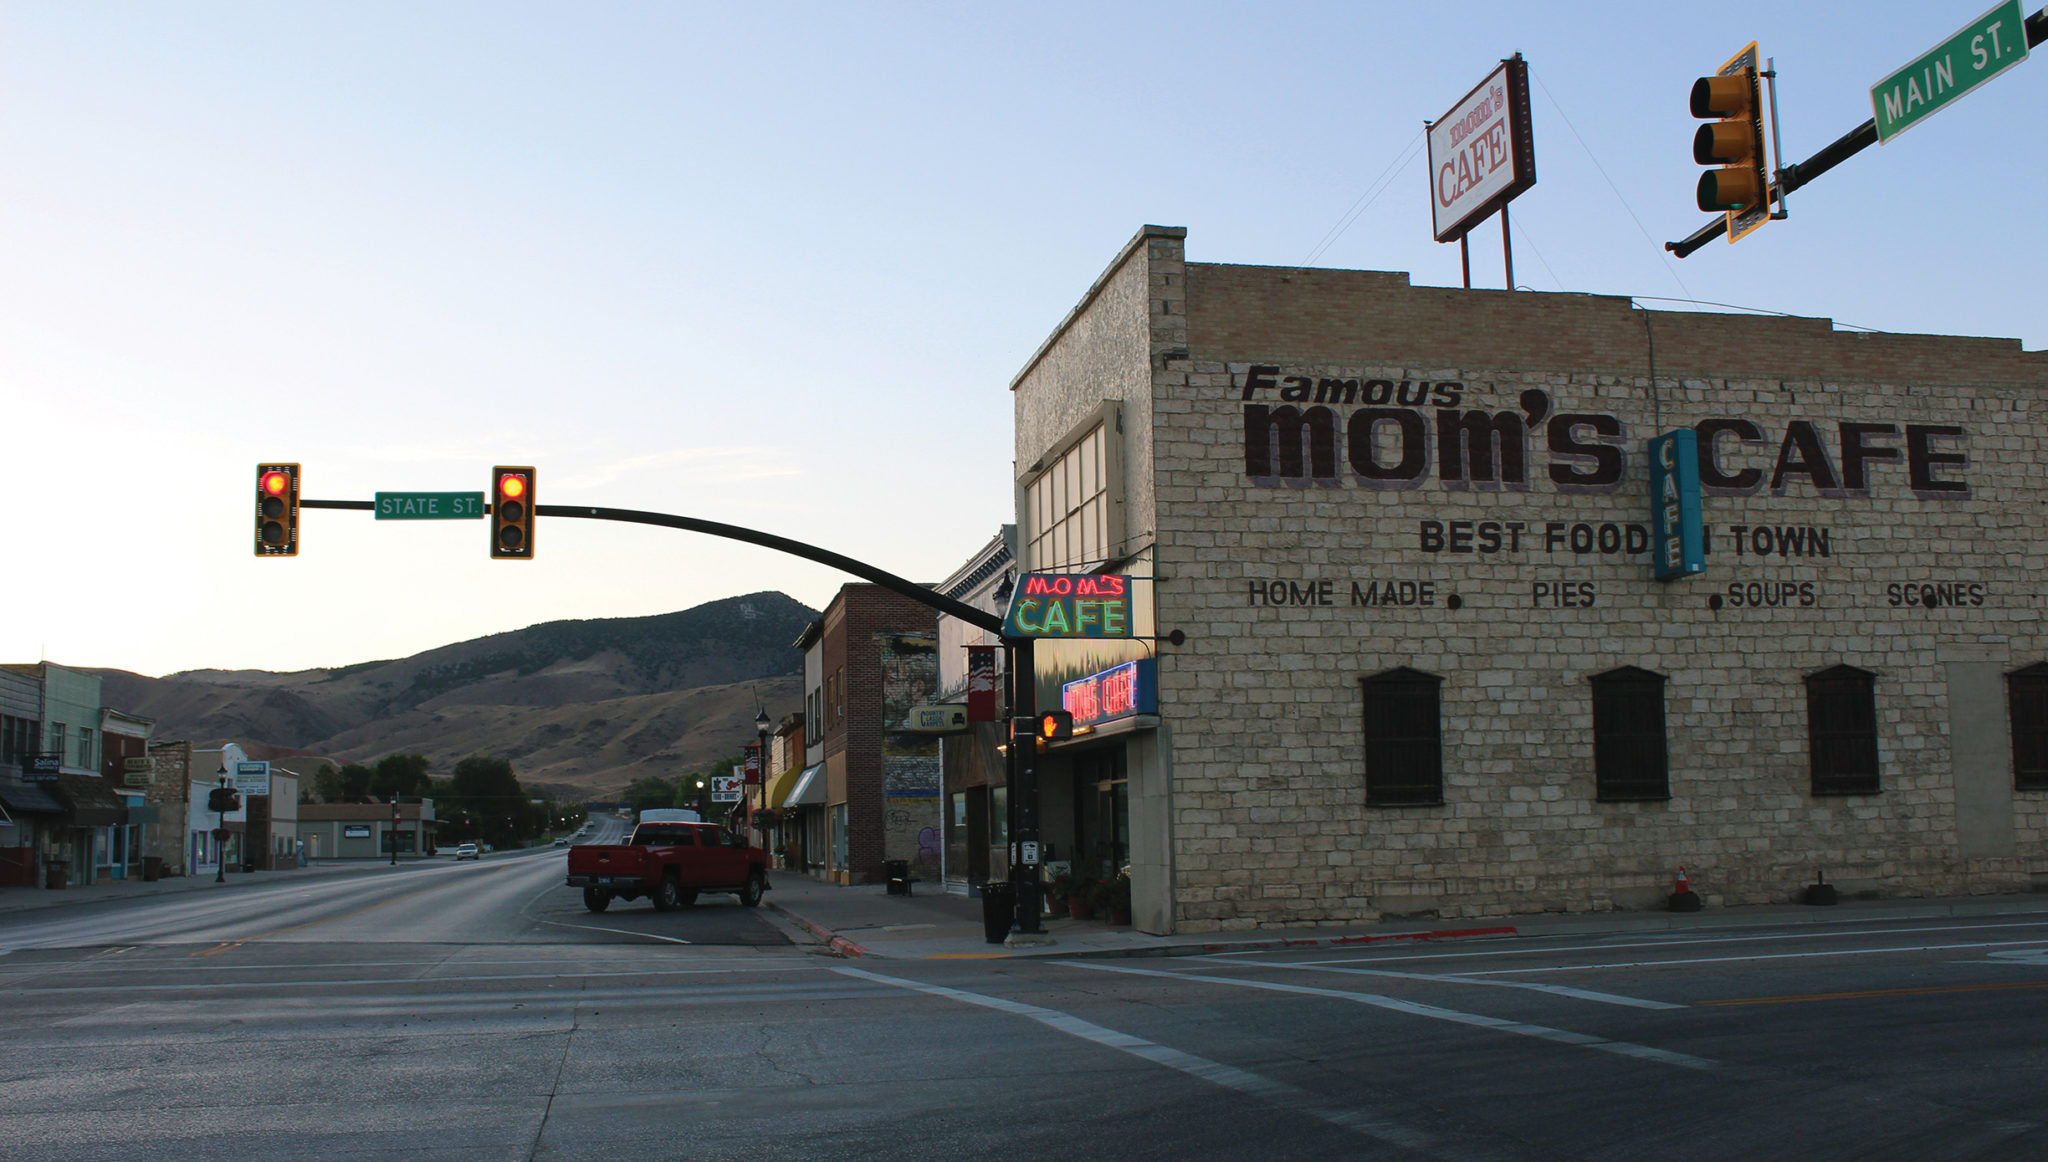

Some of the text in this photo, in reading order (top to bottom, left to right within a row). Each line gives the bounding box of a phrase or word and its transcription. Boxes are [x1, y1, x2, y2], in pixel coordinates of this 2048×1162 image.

[1883, 20, 2012, 125] MAIN ST.
[1438, 117, 1507, 208] CAFE
[1242, 365, 1465, 408] Famous
[1695, 418, 1972, 500] CAFE
[382, 497, 478, 514] STATE ST.
[1659, 438, 1681, 568] CAFE
[1420, 521, 1525, 553] BEST
[1545, 523, 1648, 555] FOOD
[1730, 525, 1830, 558] TOWN
[1249, 580, 1435, 606] HOME MADE
[1533, 582, 1596, 607] PIES
[1728, 583, 1815, 607] SOUPS
[1887, 583, 1985, 607] SCONES
[1015, 597, 1127, 634] CAFE
